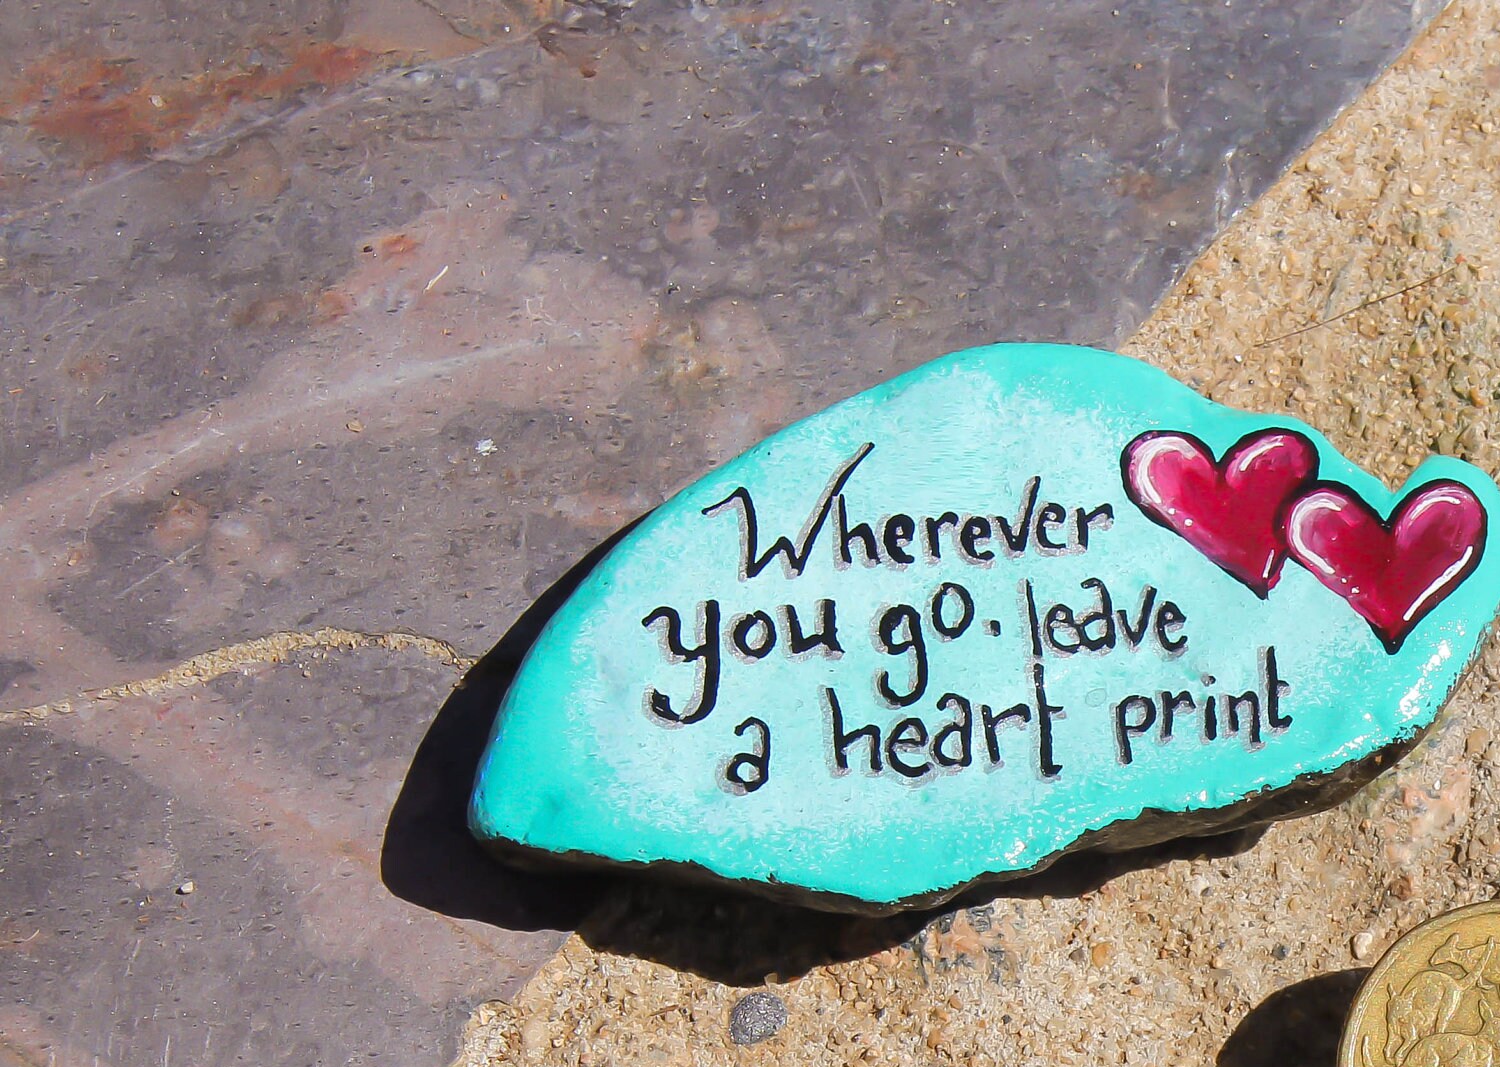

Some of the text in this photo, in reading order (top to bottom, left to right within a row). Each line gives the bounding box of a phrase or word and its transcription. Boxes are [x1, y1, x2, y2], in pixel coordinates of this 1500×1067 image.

[702, 441, 1114, 580] Wherever
[641, 596, 842, 725] you
[1024, 576, 1190, 658] leave
[722, 645, 1293, 795] a heart print
